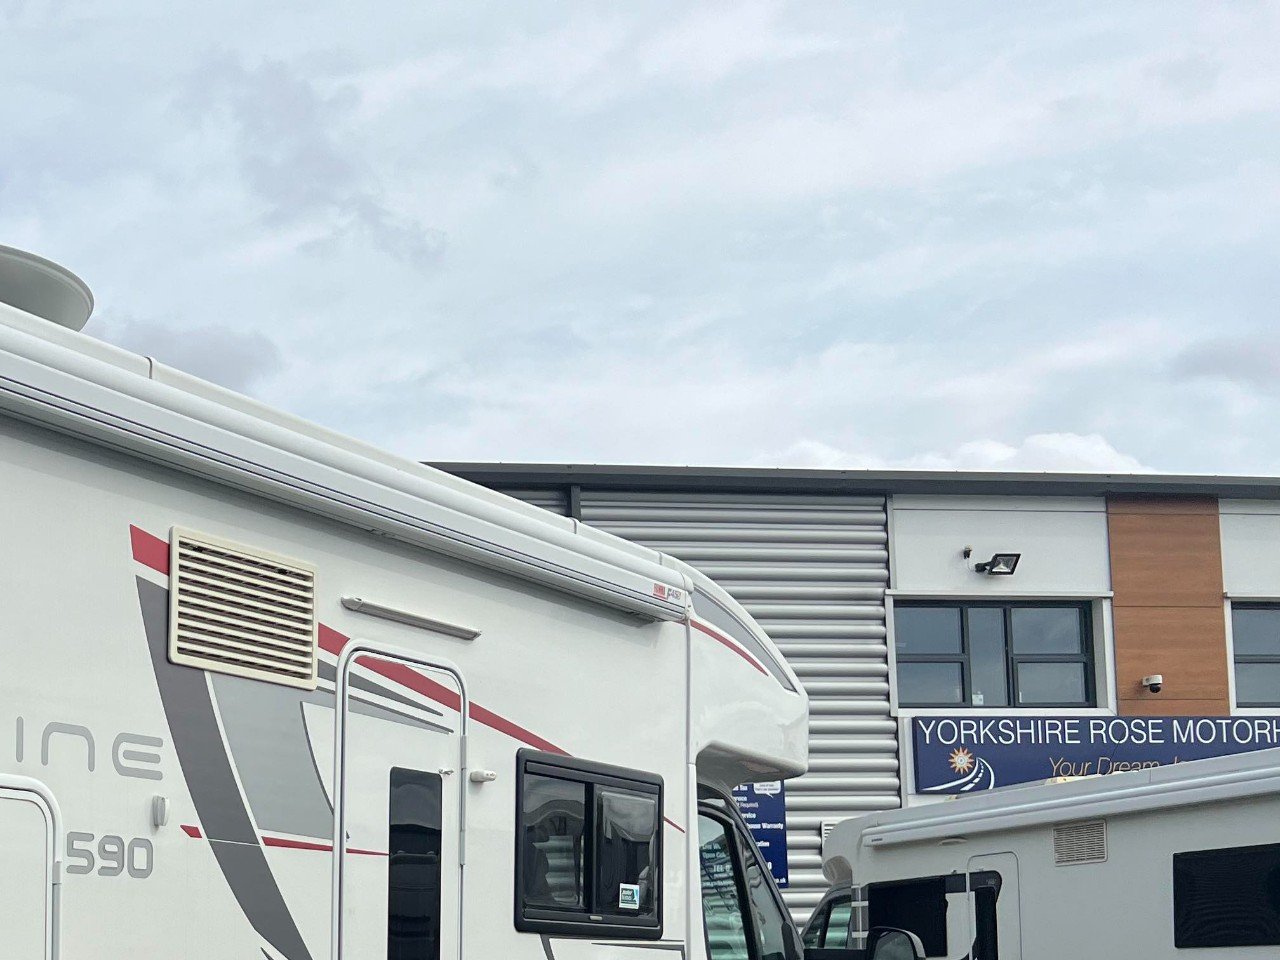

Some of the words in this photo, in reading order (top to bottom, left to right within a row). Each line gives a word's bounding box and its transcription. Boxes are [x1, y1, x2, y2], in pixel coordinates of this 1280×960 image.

[919, 719, 1081, 745] YORKSHIRE
[1089, 719, 1165, 744] ROSE
[1049, 757, 1092, 777] Your
[1097, 757, 1160, 776] Dream
[66, 831, 154, 879] 590
